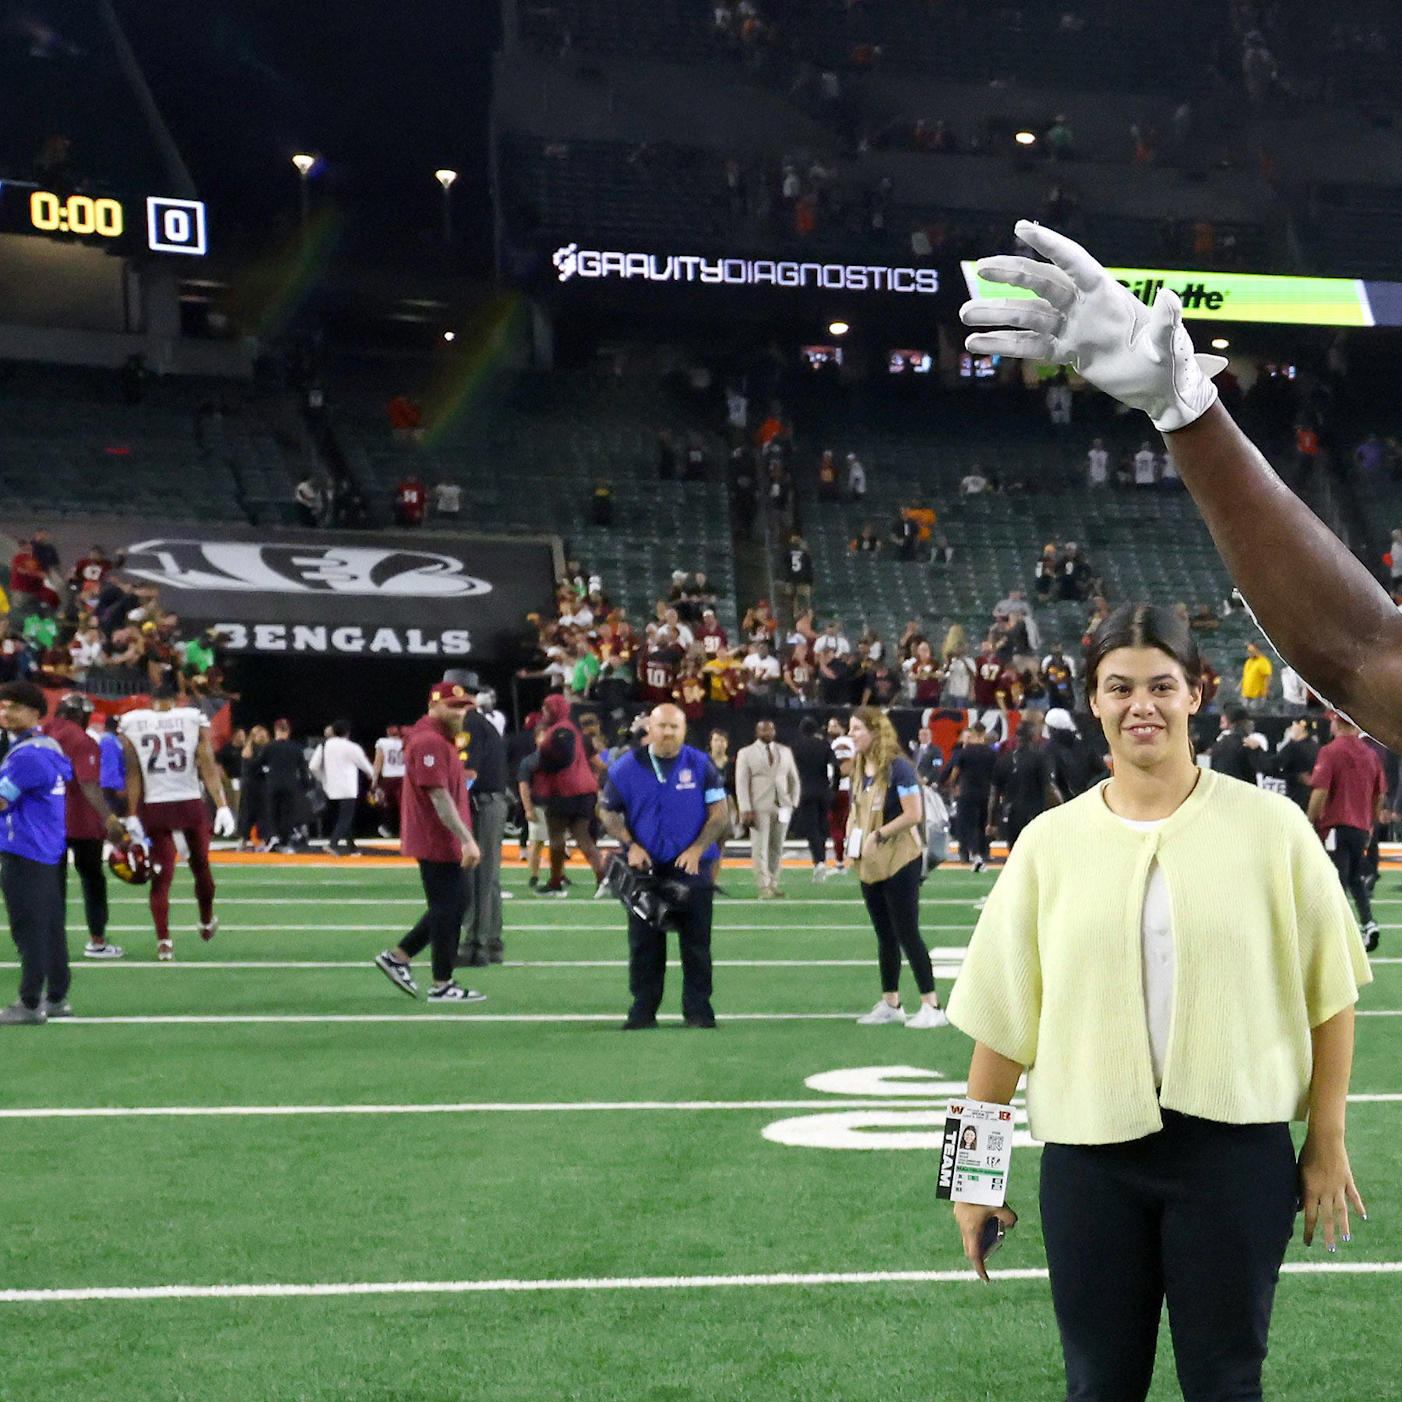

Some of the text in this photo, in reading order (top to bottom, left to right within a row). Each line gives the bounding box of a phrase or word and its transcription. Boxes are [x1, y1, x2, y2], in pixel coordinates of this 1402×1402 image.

[30, 191, 190, 243] 0:00 0
[1115, 279, 1224, 310] illtte
[212, 623, 473, 656] BENGALS
[141, 732, 188, 773] 25
[938, 1130, 958, 1188] TEAM
